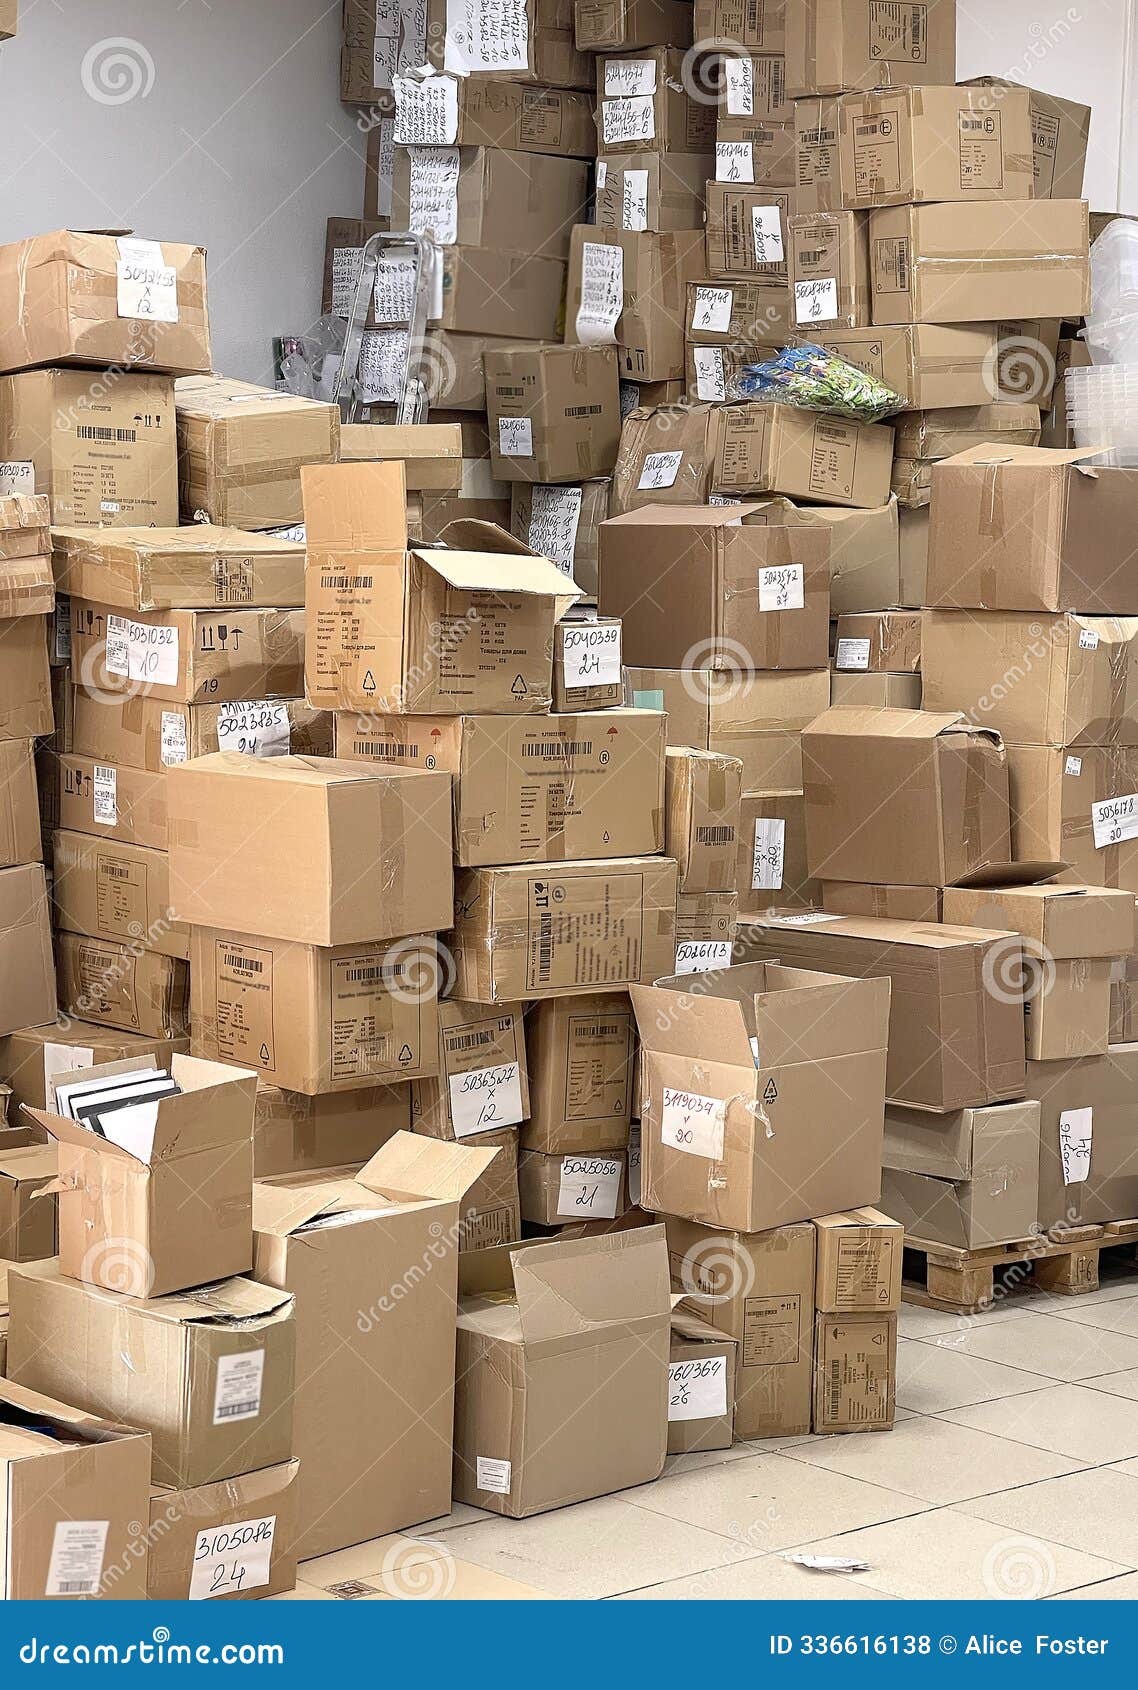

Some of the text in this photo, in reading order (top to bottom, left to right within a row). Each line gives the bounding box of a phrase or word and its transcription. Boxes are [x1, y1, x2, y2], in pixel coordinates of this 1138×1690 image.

[135, 299, 155, 315] 12
[128, 625, 174, 645] 5031032
[564, 629, 618, 650] 5040339
[139, 650, 160, 677] 10
[578, 655, 601, 675] 24
[201, 679, 219, 694] 19
[1098, 797, 1135, 823] 5036178
[1109, 827, 1122, 842] 20
[676, 943, 728, 962] 5026113
[459, 1066, 515, 1094] 5036527
[476, 1103, 503, 1126] 12
[1075, 1137, 1092, 1159] 24
[563, 1160, 617, 1176] 5025056
[576, 1185, 599, 1208] 21
[670, 1391, 691, 1407] 26
[195, 1520, 273, 1561] 3105086
[208, 1559, 246, 1593] 24
